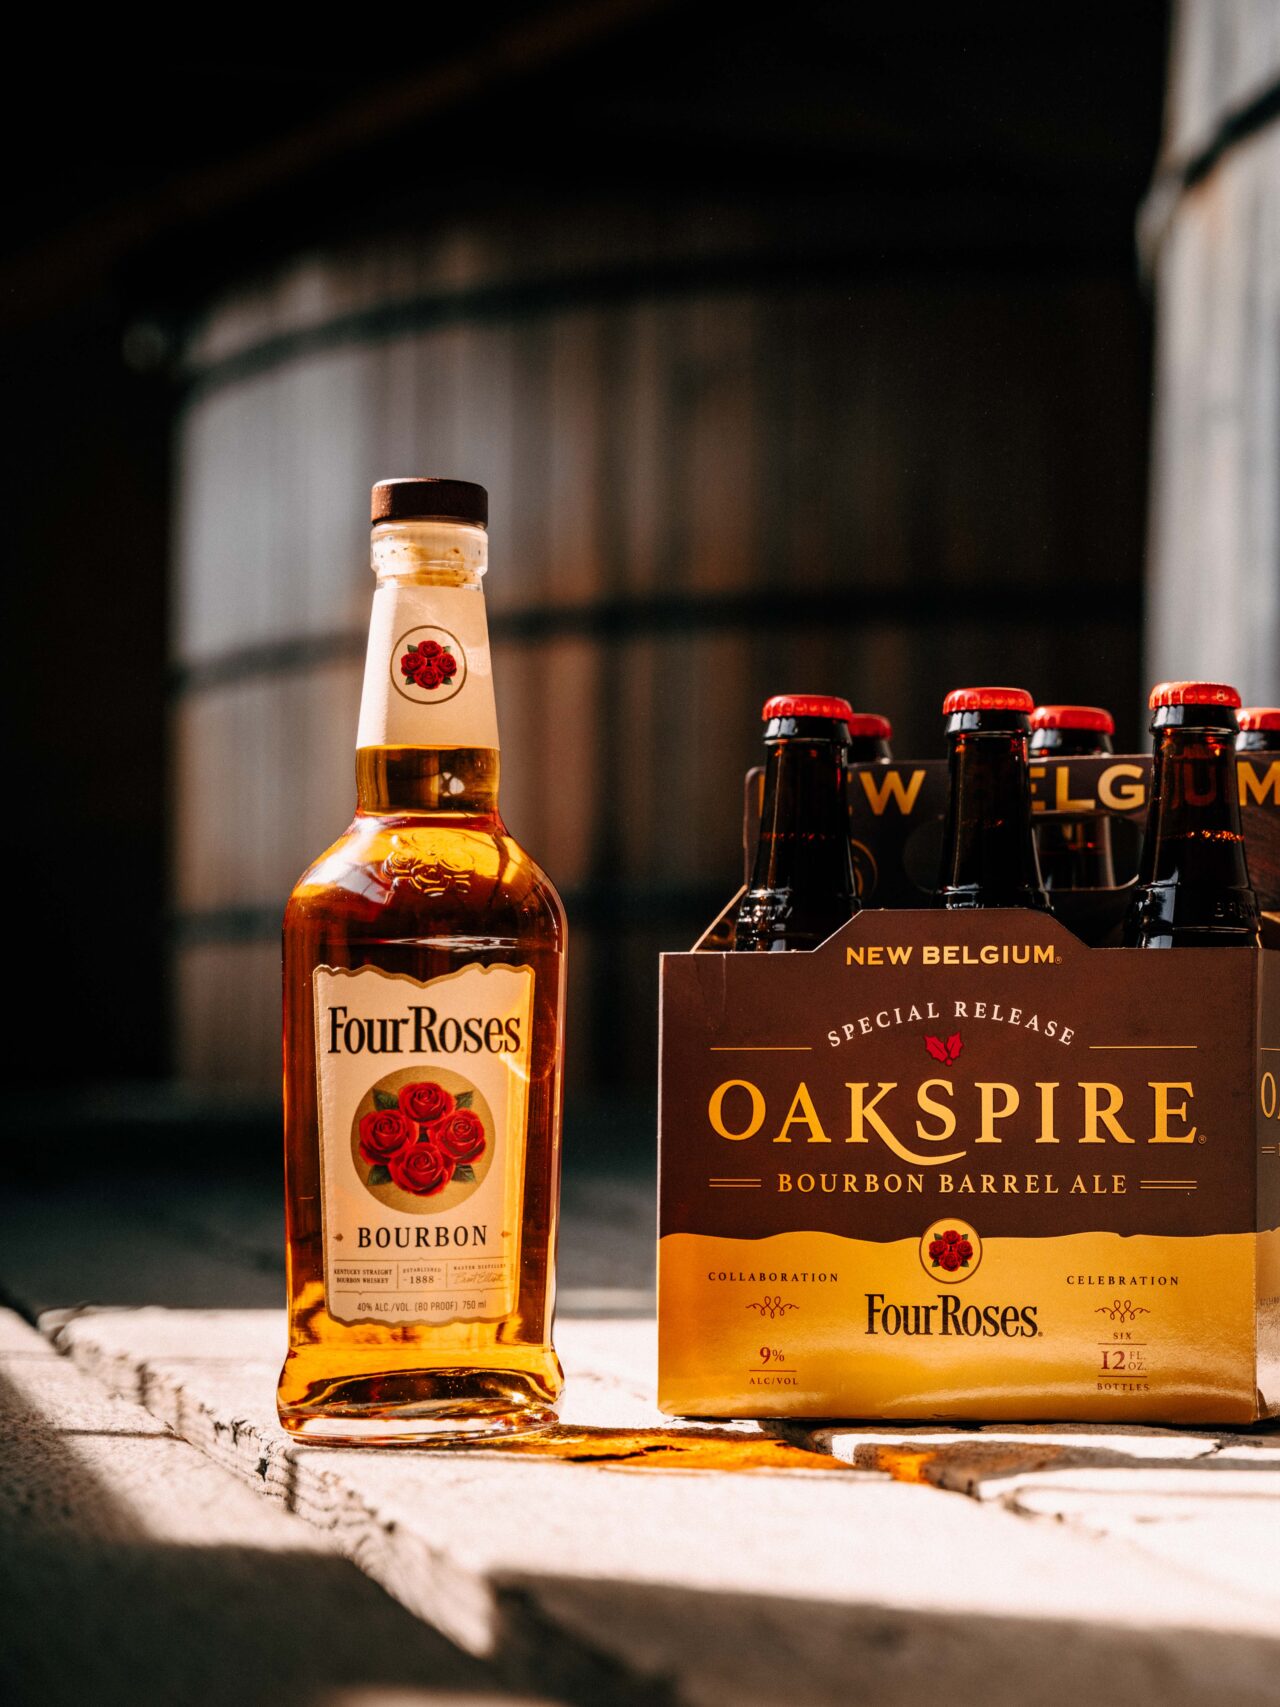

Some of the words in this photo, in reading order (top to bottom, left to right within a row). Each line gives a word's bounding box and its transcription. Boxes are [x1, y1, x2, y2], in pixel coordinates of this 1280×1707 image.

[846, 946, 913, 966] NEW
[922, 945, 1055, 965] BELGIUM
[828, 1002, 940, 1047] SPECIAL
[954, 1001, 1075, 1046] RELEASE
[708, 1078, 1198, 1166] OAKSPIRE
[777, 1174, 926, 1194] BOURBON
[938, 1174, 1060, 1194] BARREL
[1069, 1174, 1128, 1195] ALE
[358, 1225, 488, 1248] BOURBON
[334, 1268, 361, 1276] KENTUCKY
[362, 1268, 392, 1276] STRAIGHT
[708, 1272, 839, 1283] COLLABORATION
[410, 1275, 435, 1285] 1888
[1066, 1276, 1179, 1286] CELEBRATION
[357, 1302, 373, 1312] 40%
[462, 1300, 476, 1310] 750
[1113, 1332, 1132, 1340] SIX
[759, 1346, 785, 1364] 9%
[1100, 1351, 1127, 1370] 12
[749, 1377, 799, 1385] ALC/VOL
[1097, 1383, 1149, 1391] BOTTLES
